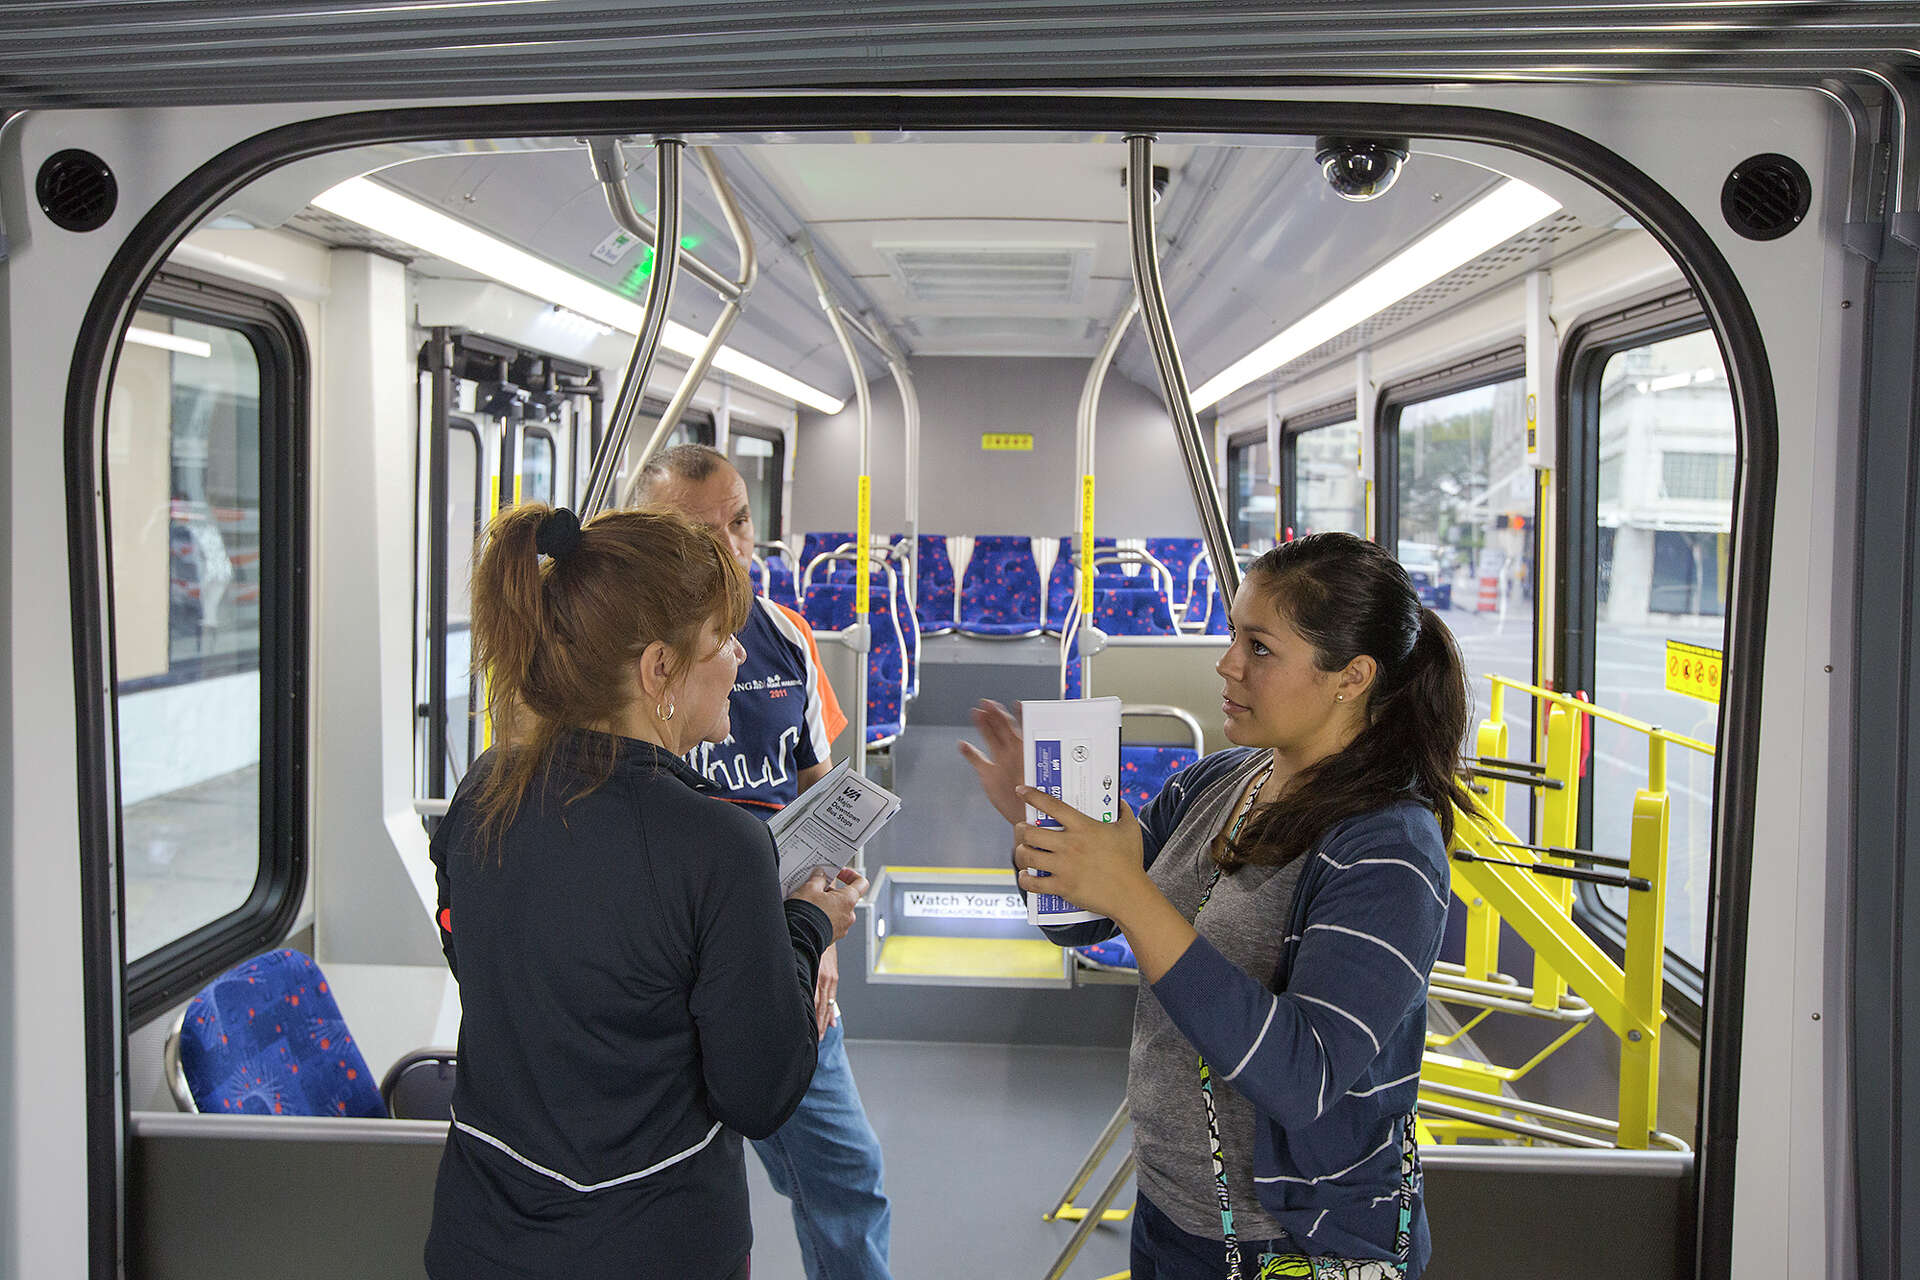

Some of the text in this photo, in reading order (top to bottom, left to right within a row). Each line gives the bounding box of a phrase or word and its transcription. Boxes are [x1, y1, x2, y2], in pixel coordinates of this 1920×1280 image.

[733, 682, 753, 692] ING
[769, 689, 788, 699] 2011
[842, 786, 862, 802] VIA
[836, 796, 853, 809] Major
[826, 807, 853, 828] Bus Stops
[831, 801, 861, 824] Downtown
[910, 894, 960, 906] Watch
[965, 895, 1000, 907] Your
[1005, 896, 1026, 908] St
